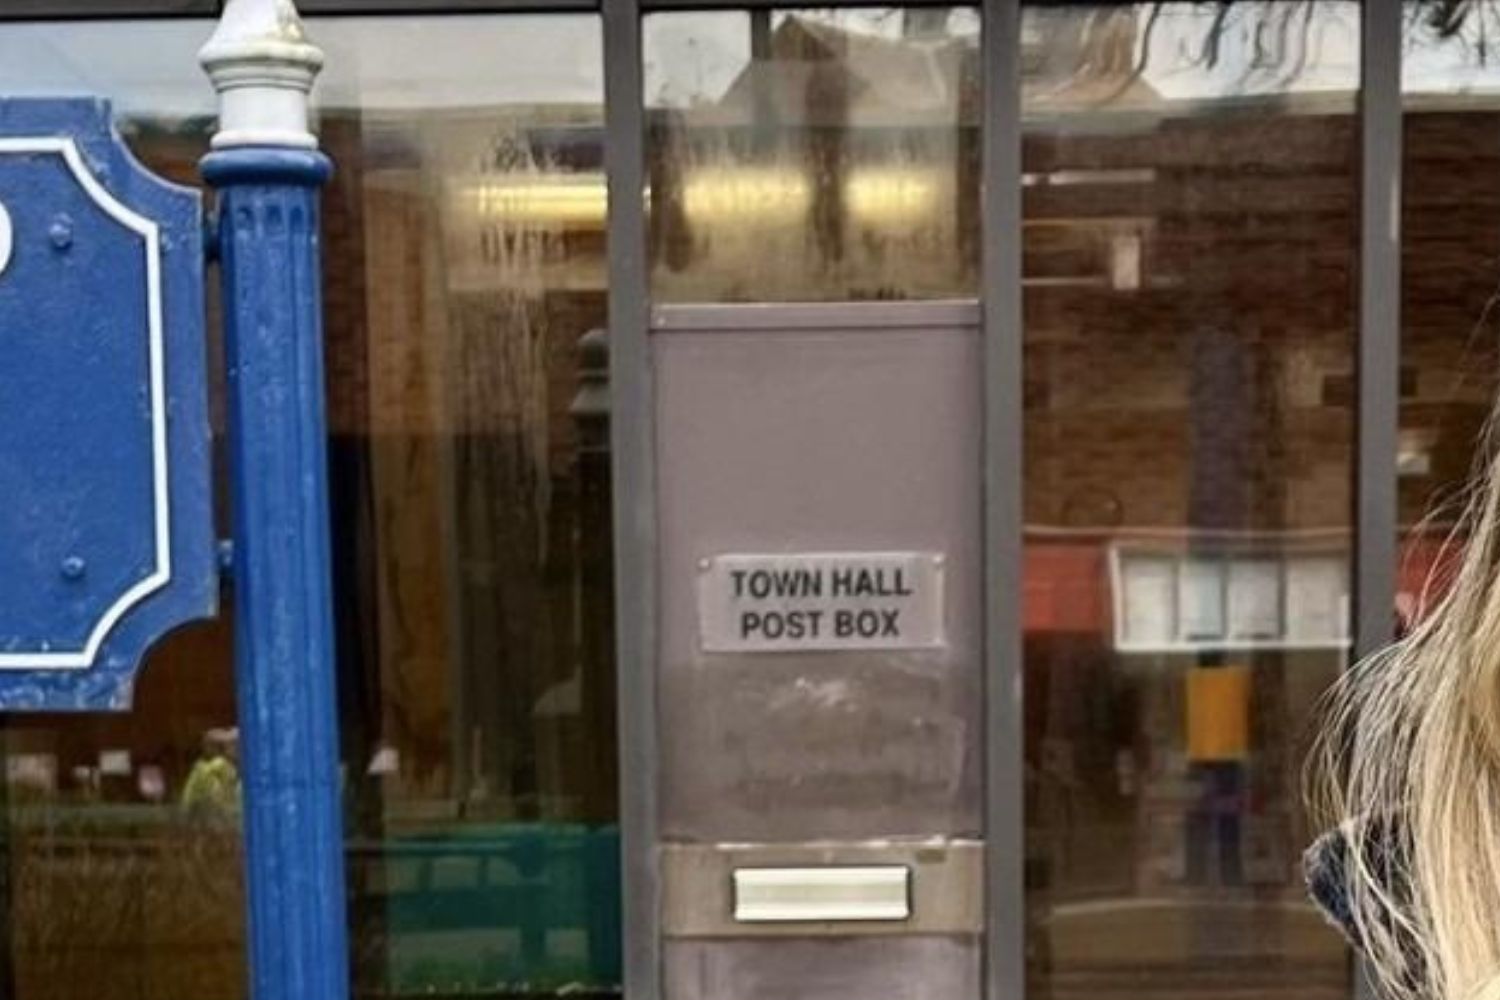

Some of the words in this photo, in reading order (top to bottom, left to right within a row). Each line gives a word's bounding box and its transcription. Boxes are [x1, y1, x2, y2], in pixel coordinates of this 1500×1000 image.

[730, 569, 822, 600] TOWN
[831, 568, 913, 598] HALL
[740, 610, 824, 640] POST
[835, 609, 901, 638] BOX
